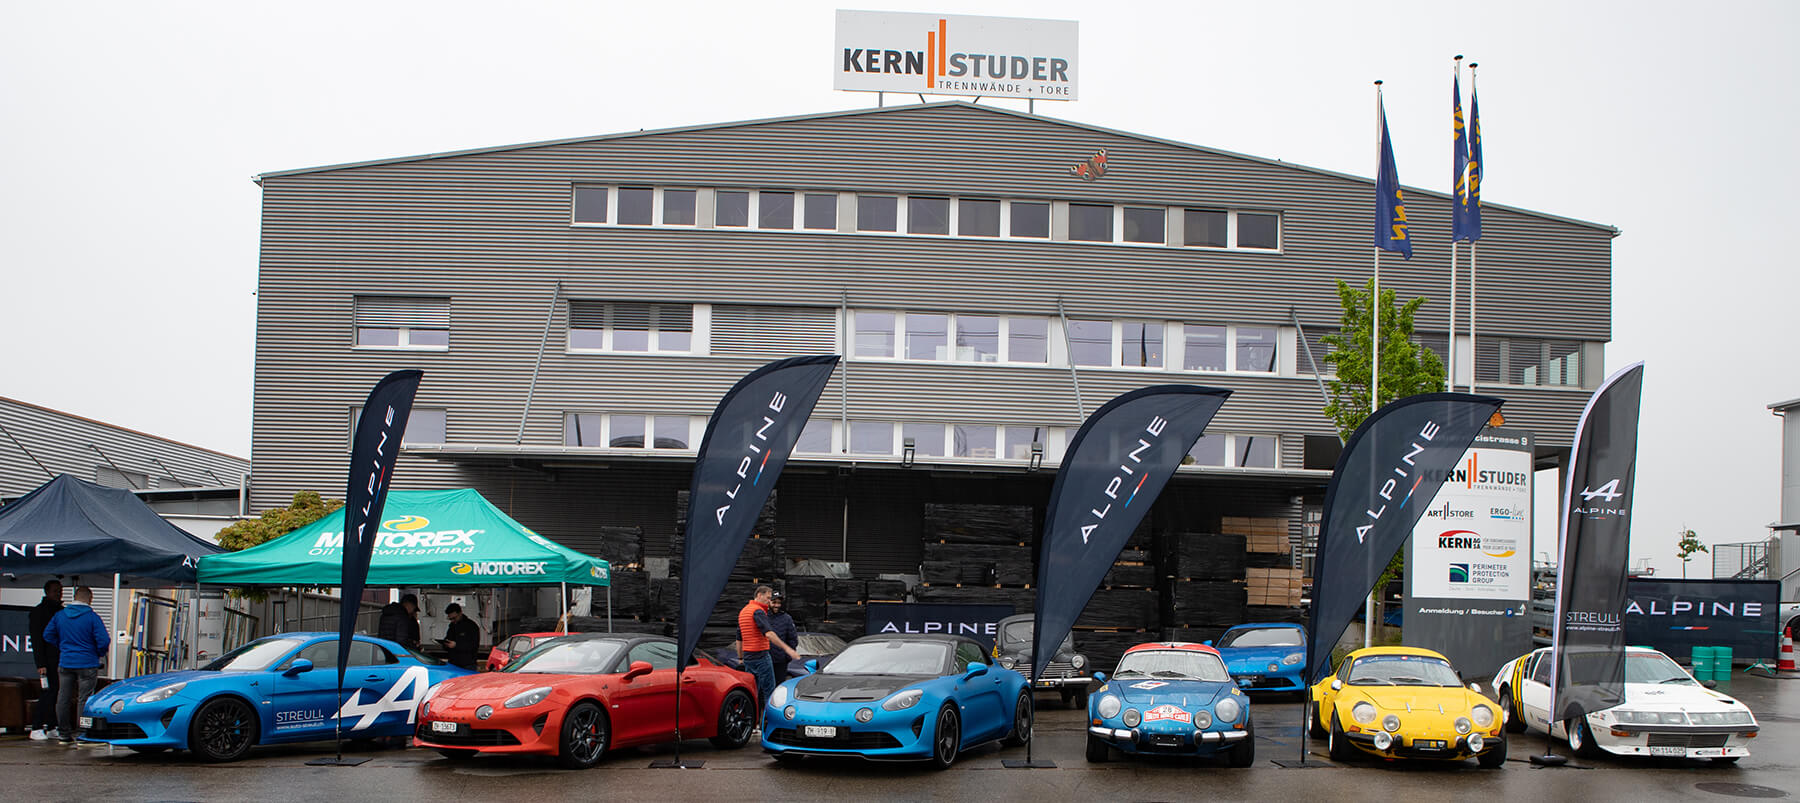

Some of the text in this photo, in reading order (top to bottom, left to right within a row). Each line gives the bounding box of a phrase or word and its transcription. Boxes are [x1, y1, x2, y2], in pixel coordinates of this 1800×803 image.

[843, 48, 1069, 82] KERN STUDER
[939, 80, 1021, 94] TRENNWÄNDE
[1040, 86, 1070, 96] TORE
[1521, 437, 1528, 446] 9
[716, 391, 788, 527] ALPINE
[358, 405, 395, 545] ALPINE
[1080, 415, 1168, 545] ALPINE
[1355, 420, 1440, 545] ALPINE
[1478, 470, 1527, 487] STUDER
[1449, 510, 1475, 518] STORE
[1573, 507, 1625, 516] ALPINE
[313, 529, 480, 548] MTOREX
[1438, 537, 1473, 549] KERN
[308, 547, 333, 556] Oil
[472, 561, 545, 576] MOTOREX
[1472, 563, 1508, 571] PERIMETER
[1472, 570, 1510, 578] PROTECTION
[1418, 607, 1465, 616] Anmeldung
[1625, 601, 1763, 618] ALPINE
[880, 621, 997, 635] ALPINE
